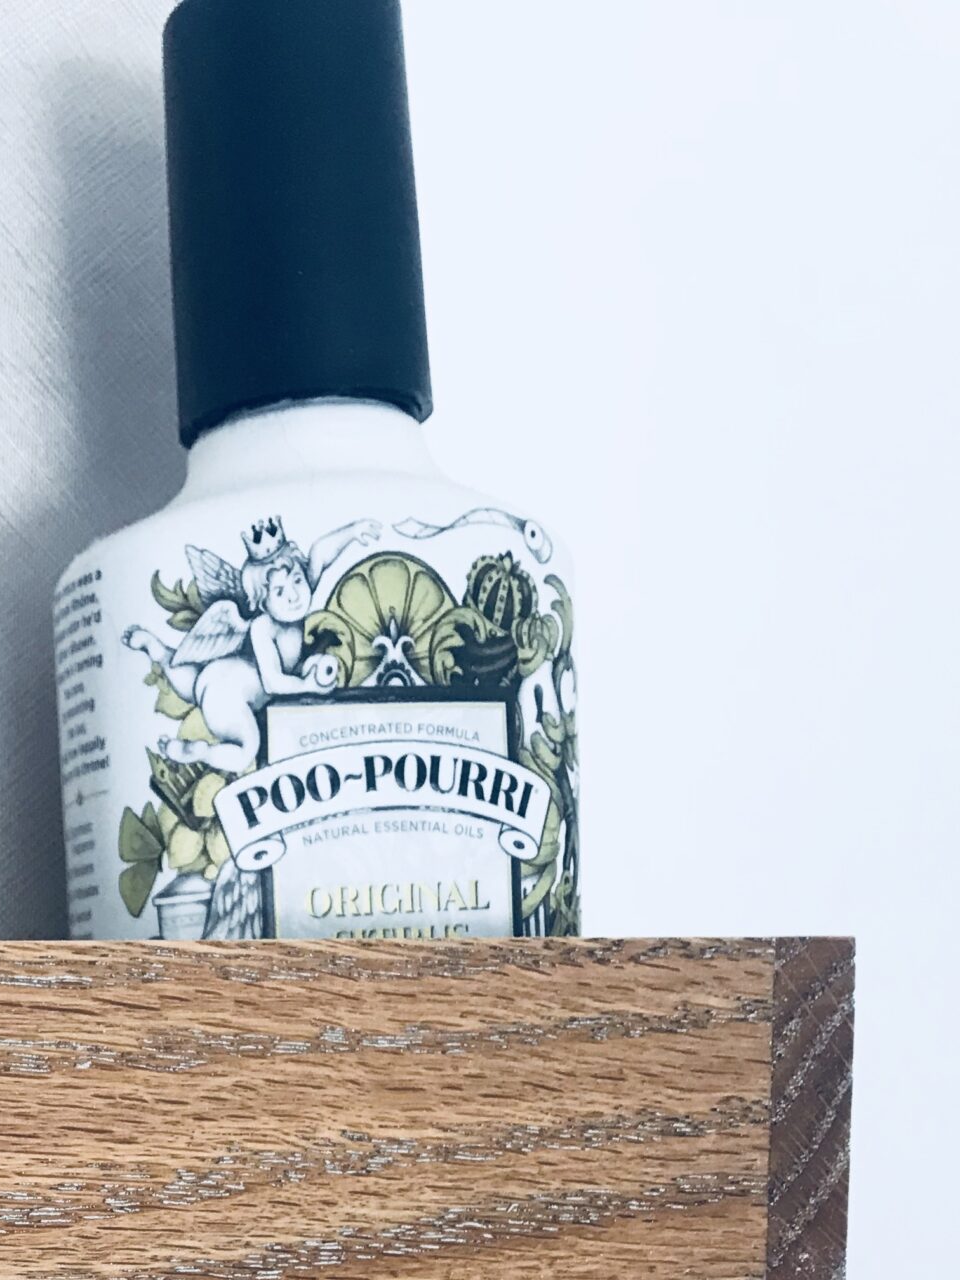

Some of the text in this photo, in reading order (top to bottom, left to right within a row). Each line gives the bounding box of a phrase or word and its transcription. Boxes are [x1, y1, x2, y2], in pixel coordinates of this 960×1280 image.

[299, 722, 480, 748] CONCENTRATED FORMULA
[302, 820, 484, 847] NATURAL ESSENTIAL OILS
[305, 879, 491, 919] ORIGINAL
